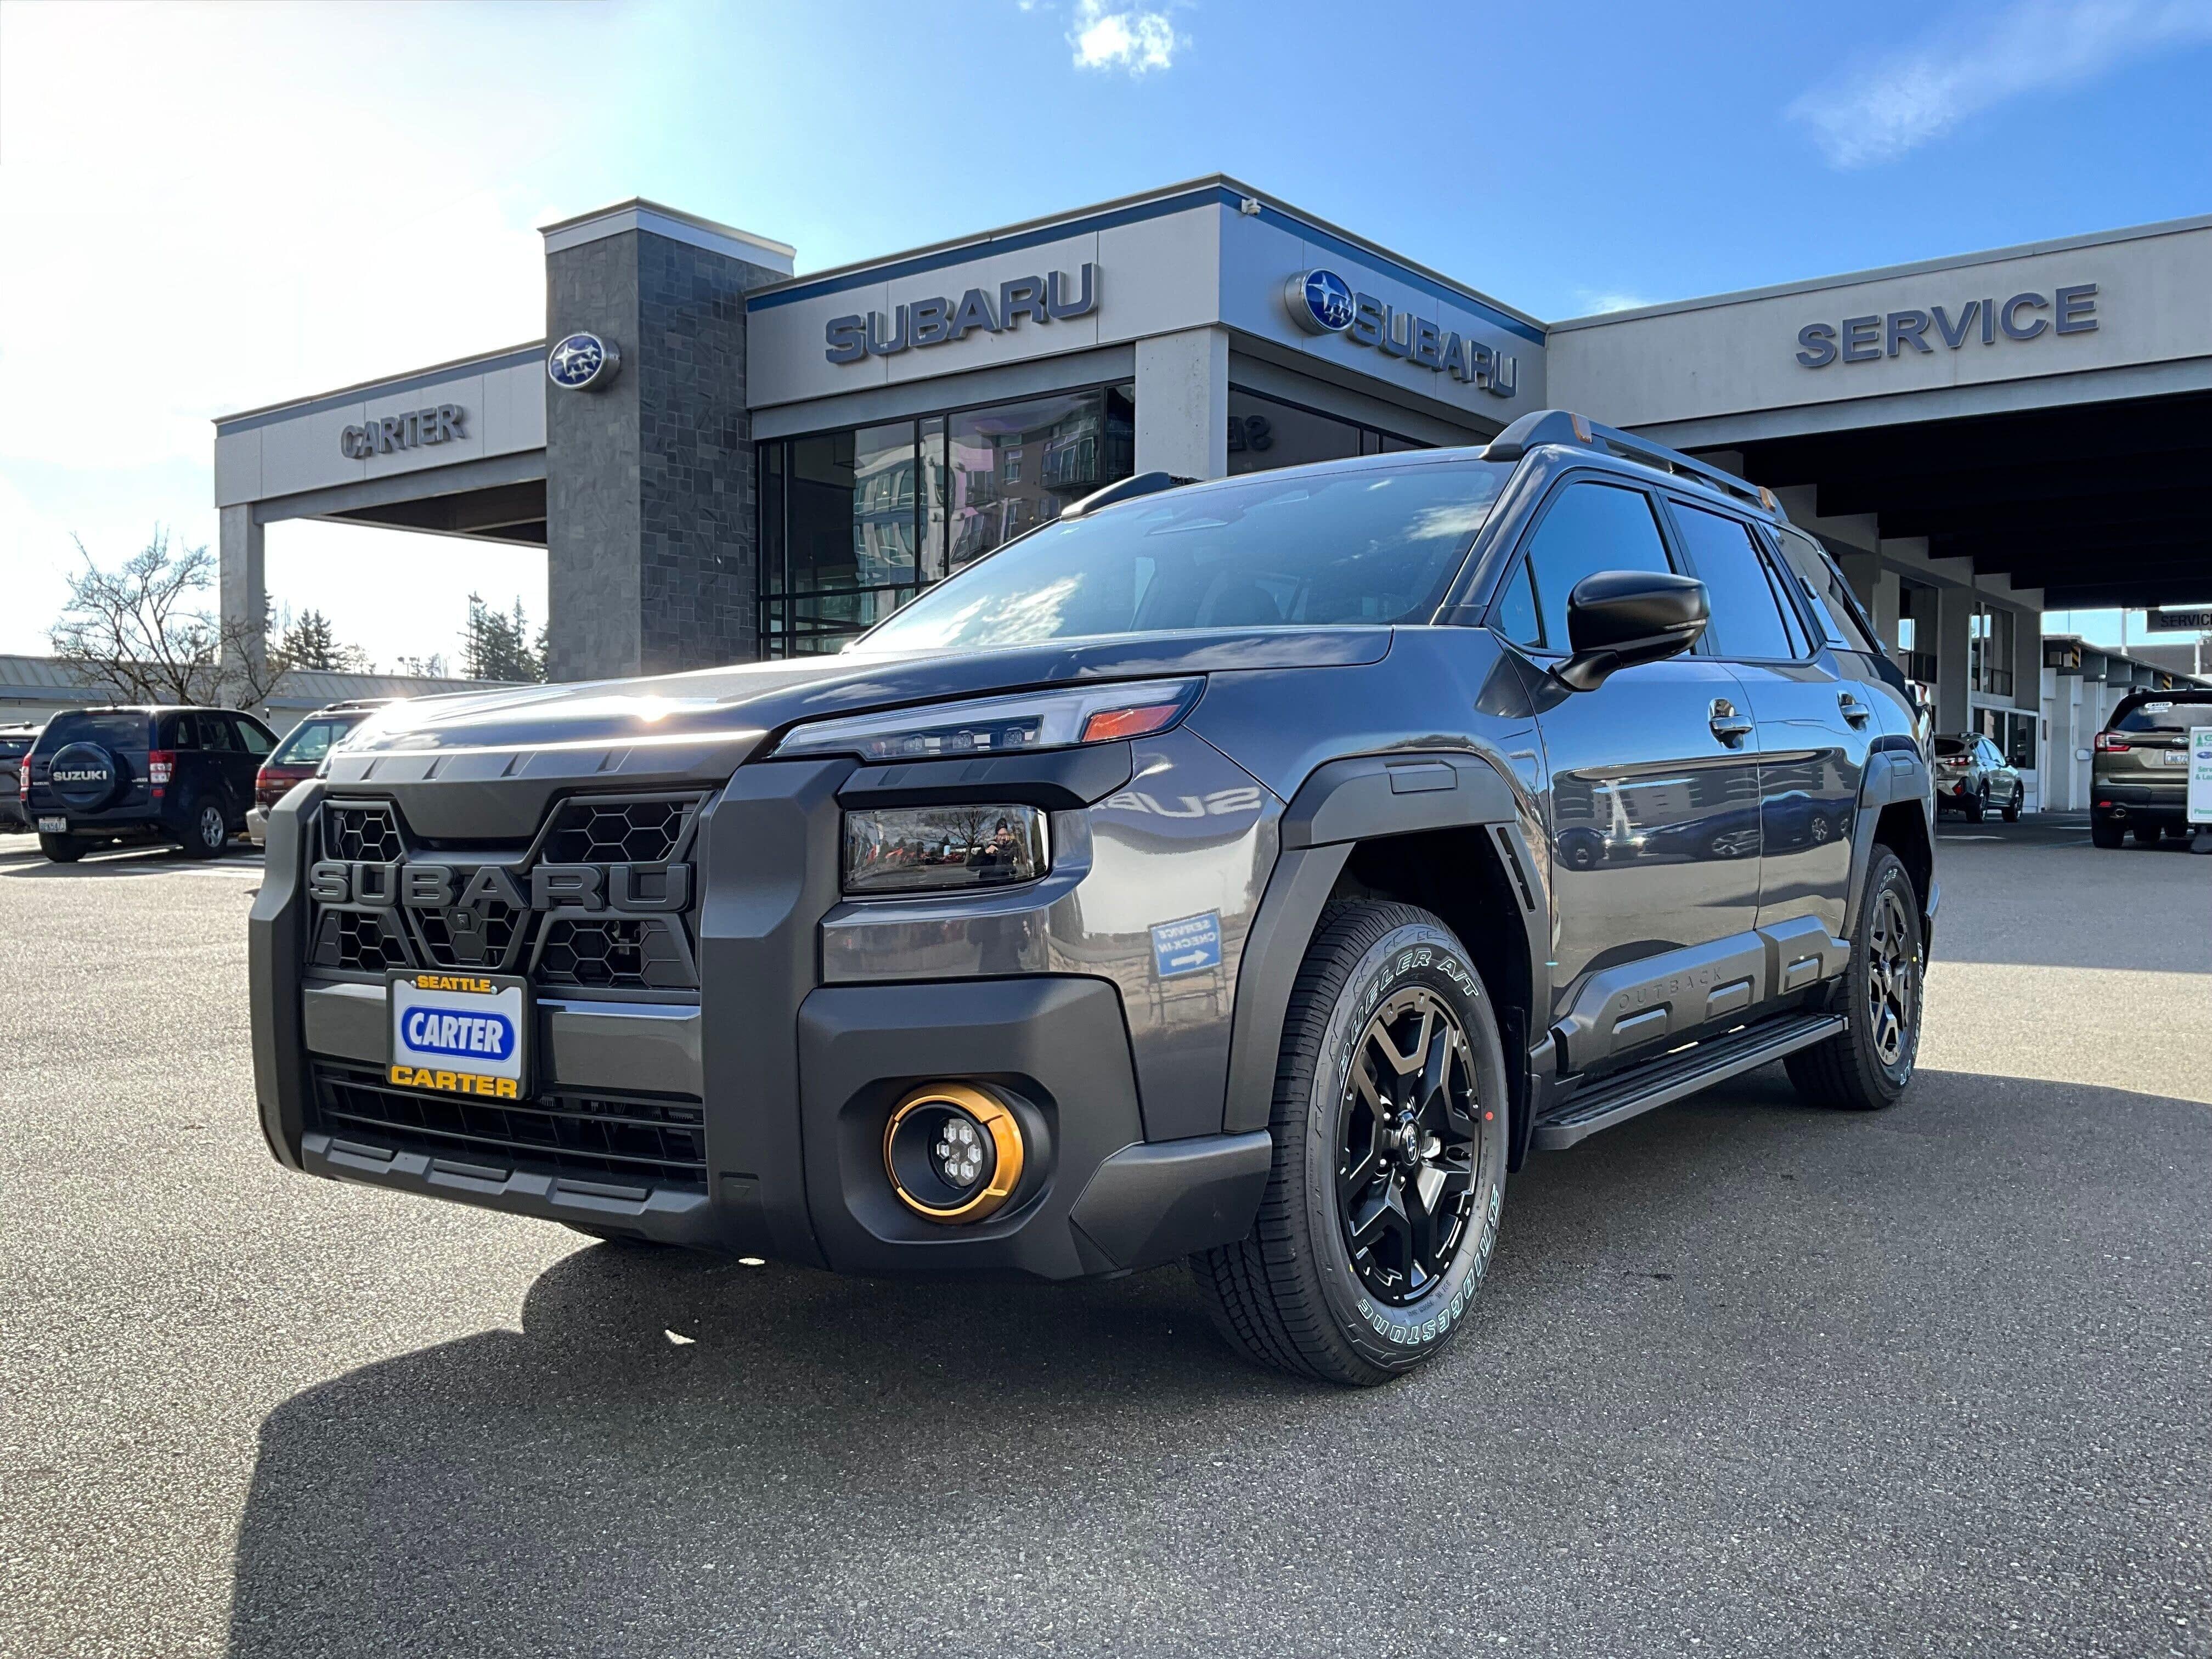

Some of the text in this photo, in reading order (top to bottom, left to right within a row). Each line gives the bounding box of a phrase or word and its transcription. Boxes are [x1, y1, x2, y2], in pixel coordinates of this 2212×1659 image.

[825, 262, 1098, 364] SUBARU
[1795, 283, 2099, 368] SERVICE
[1351, 292, 1518, 398] SUBARU
[341, 403, 466, 459] CARTER
[2160, 613, 2212, 627] SERVIC
[53, 770, 108, 781] SUZUKI
[310, 861, 692, 912] SUBARU
[416, 974, 491, 992] SEATTLE
[1619, 966, 1722, 1011] OUTBACK
[409, 1012, 502, 1053] CARTER
[1338, 949, 1432, 1090] DUELER
[391, 1065, 517, 1098] CARTER
[1357, 1183, 1500, 1345] BRIDGESTONE
